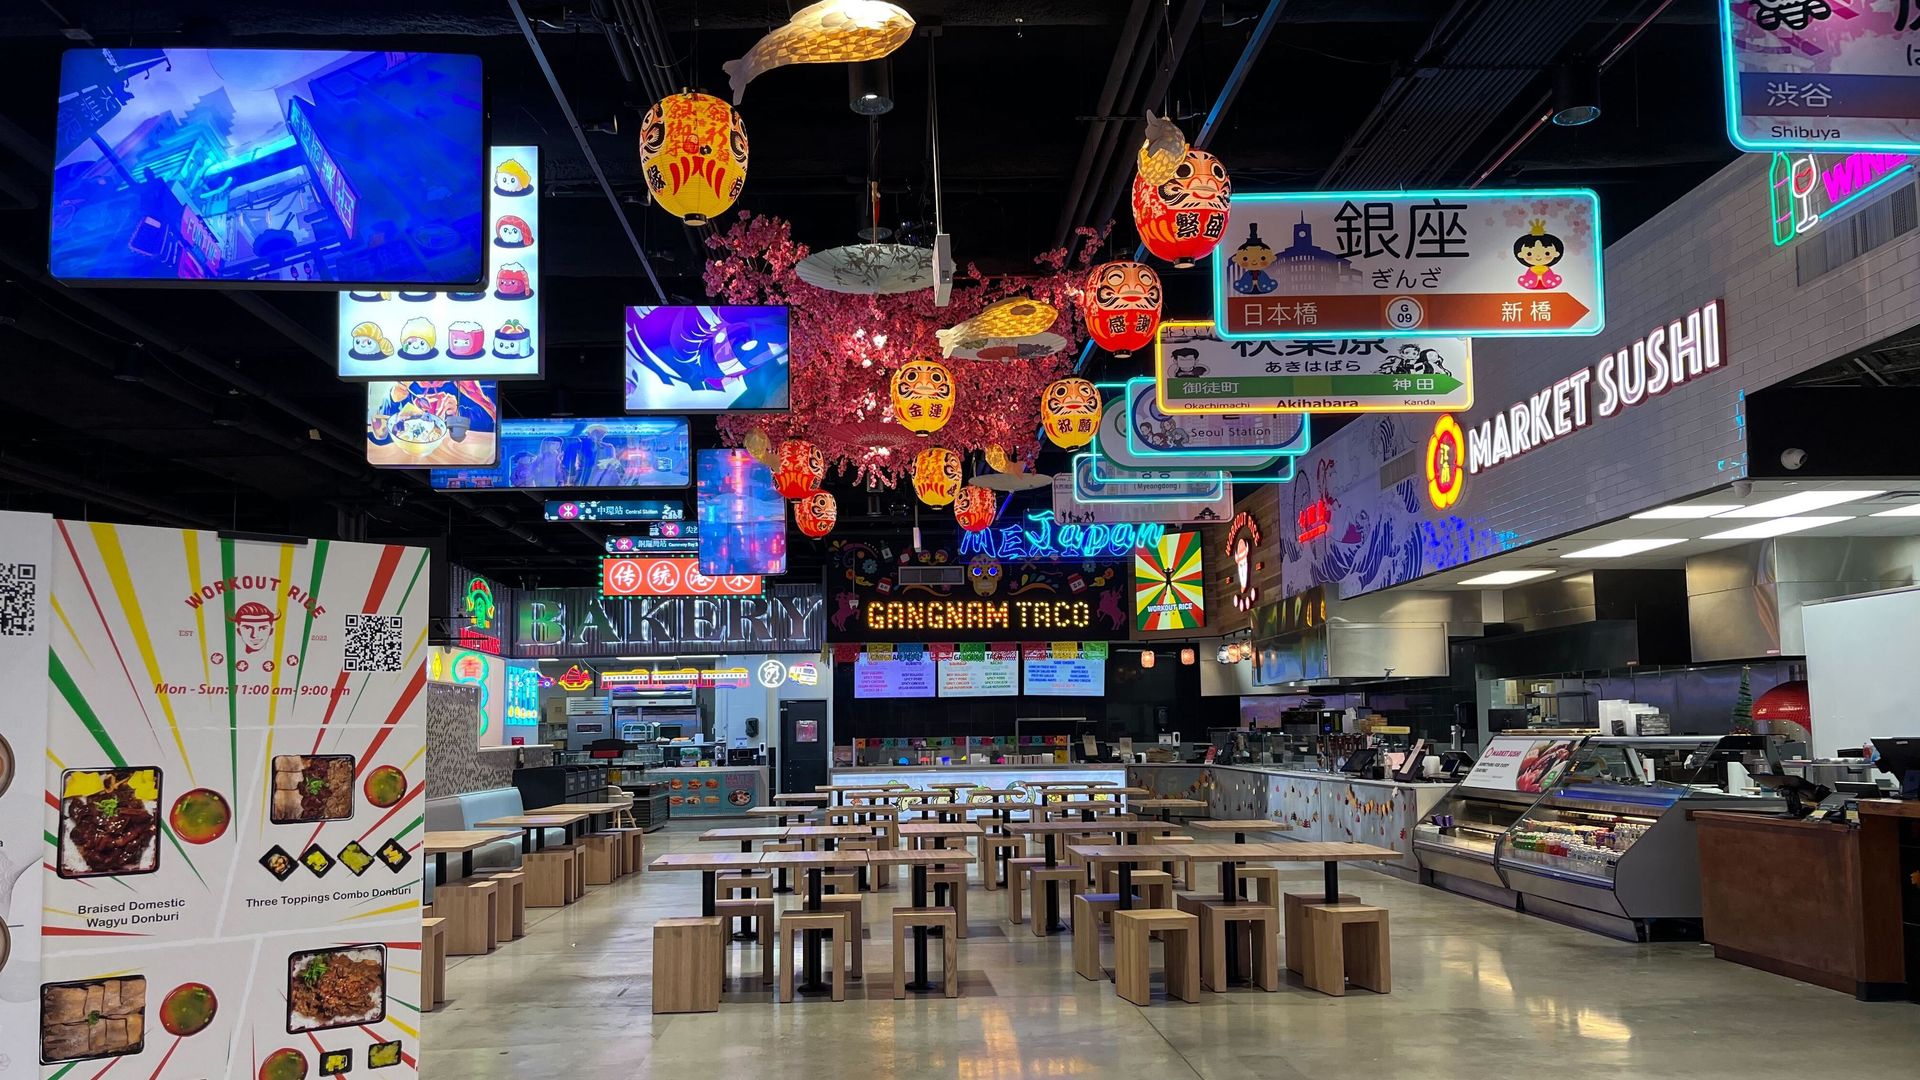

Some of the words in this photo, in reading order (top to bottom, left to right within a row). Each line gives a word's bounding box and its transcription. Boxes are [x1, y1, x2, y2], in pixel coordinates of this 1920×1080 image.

[1767, 81, 1832, 107] 渋谷
[1771, 126, 1841, 140] Shibuya
[1175, 212, 1225, 239] 繁盛
[1334, 198, 1470, 260] 銀座
[1371, 267, 1442, 290] ぎんざ
[1244, 302, 1318, 327] 日本橋
[1396, 312, 1413, 324] 09
[1400, 304, 1408, 312] G
[1501, 301, 1552, 323] 新橋
[1108, 314, 1150, 334] 感謝
[1265, 361, 1361, 373] あきはばら
[1182, 382, 1239, 395] 御徒町
[1392, 378, 1434, 391] 神田
[1469, 367, 1591, 475] MARKET
[1600, 300, 1722, 417] SUSHI
[908, 403, 944, 418] 金運
[1184, 402, 1250, 410] Okachimachi
[1276, 399, 1359, 409] Akihabara
[1191, 428, 1224, 438] Seoul
[1228, 427, 1271, 437] Station
[1025, 510, 1165, 557] Japan
[184, 575, 281, 610] WORKOUT
[287, 585, 326, 619] RICE
[867, 601, 1009, 629] GANGNAM
[1016, 601, 1090, 628] TACO
[1147, 604, 1176, 613] WORKOUT
[1178, 602, 1193, 611] RICE
[519, 596, 823, 646] BAKERY
[154, 684, 187, 694] Mon
[198, 684, 229, 695] Sun:
[232, 685, 270, 695] 11:00
[300, 685, 328, 696] 9:00
[77, 901, 126, 916] Braised
[128, 897, 186, 913] Domestic
[246, 896, 278, 908] Three
[281, 893, 330, 907] Toppings
[332, 889, 370, 901] Combo
[372, 885, 412, 898] Donburi
[86, 914, 129, 930] Wagyu
[131, 910, 180, 925] Donburi
